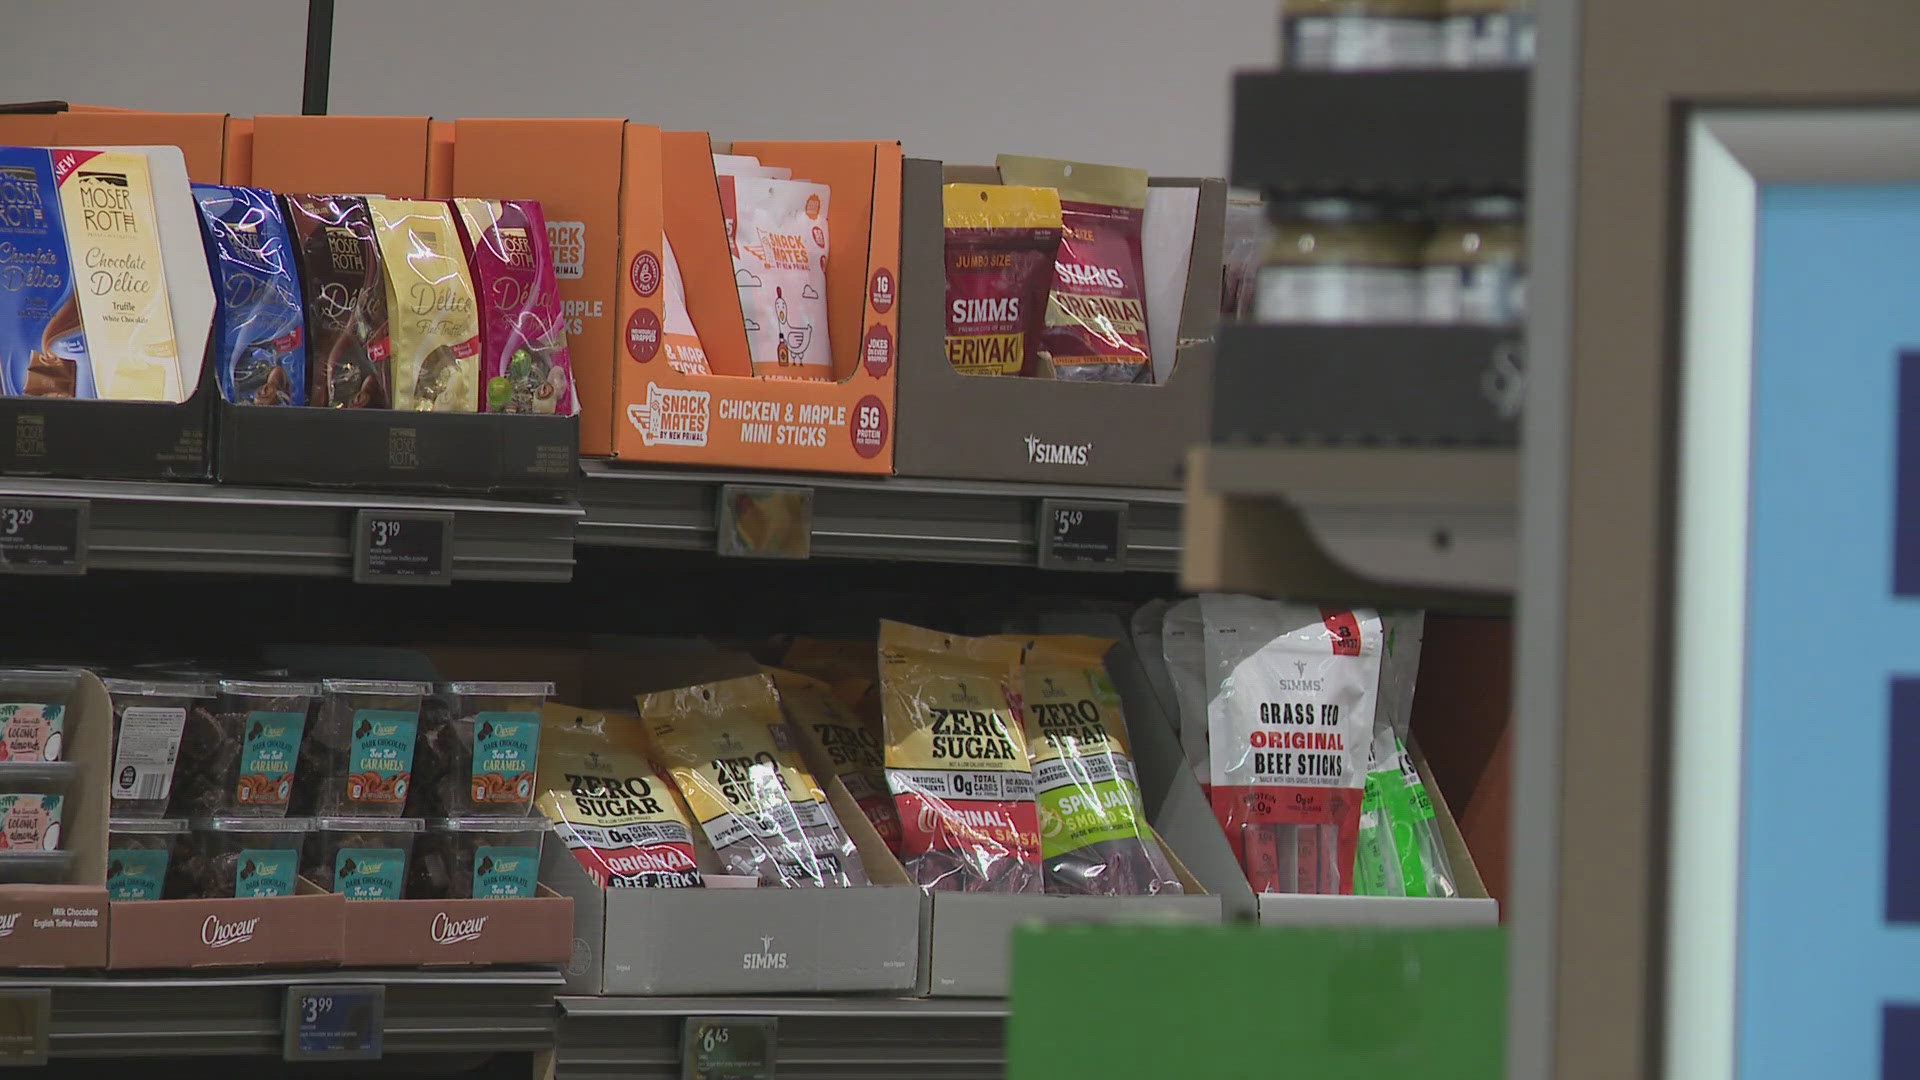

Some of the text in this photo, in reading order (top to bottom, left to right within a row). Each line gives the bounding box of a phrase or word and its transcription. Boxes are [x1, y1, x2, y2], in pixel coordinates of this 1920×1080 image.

[56, 153, 76, 180] NEW
[0, 182, 42, 206] OSER
[79, 187, 133, 211] MOSER
[84, 209, 138, 233] ROTH
[547, 227, 580, 246] ACK
[769, 233, 804, 250] SNACK
[1075, 229, 1094, 242] SIZE
[328, 236, 361, 254] MOSER
[501, 237, 532, 253] OSER
[85, 247, 146, 271] Chocolate
[332, 253, 365, 271] ROTH
[552, 246, 580, 264] TES
[773, 248, 809, 264] MATES
[956, 255, 1012, 268] JUMBO SIZE
[2, 265, 62, 292] Délice
[554, 266, 578, 275] RIMAL
[1055, 262, 1124, 289] SIMMS
[90, 269, 150, 296] Délice
[877, 276, 888, 293] 1G
[112, 301, 136, 312] Truffle
[953, 298, 1019, 323] SIMMS
[103, 315, 120, 323] White
[631, 334, 656, 343] WRAPPED
[868, 339, 888, 350] JOKES
[678, 345, 707, 364] MAP
[945, 338, 1018, 365] ERIYAKI
[662, 395, 707, 413] SNACK
[719, 399, 846, 425] CHICKEN & MAPLE
[660, 413, 704, 431] MATES
[860, 406, 880, 429] 5G
[660, 431, 703, 441] BY NEW PRIMAL
[741, 423, 827, 447] MINI STICKS
[857, 427, 880, 438] PROTEIN
[1036, 443, 1087, 465] SIMMS
[1279, 679, 1321, 692] SIMMS
[929, 708, 1006, 738] ZERO
[1030, 700, 1100, 728] ZERO
[1260, 703, 1339, 726] GRASS FED
[8, 728, 39, 739] COCONUT
[1250, 730, 1344, 750] ORIGINAL
[370, 748, 397, 758] Sea Salt
[492, 749, 518, 759] Sea Salt
[932, 737, 1016, 760] SUGAR
[250, 760, 289, 772] CARAMELS
[361, 758, 404, 771] CARAMELS
[484, 760, 526, 771] CARAMELS
[1086, 757, 1107, 768] TOTAL
[1255, 753, 1342, 776] BEEF STICKS
[565, 773, 651, 799] ZERO
[953, 774, 973, 796] 0g
[974, 775, 996, 783] TOTAL
[974, 783, 998, 792] CARBS
[575, 797, 664, 818] SUGAR
[8, 818, 38, 829] COCONUT
[627, 825, 652, 834] TOTAL
[608, 830, 633, 843] 0g
[608, 852, 693, 872] ORIGINAL
[613, 871, 701, 888] BEEF JERKY
[354, 886, 382, 896] Sea Salt
[491, 885, 518, 895] Sea Salt
[53, 908, 98, 916] Milk Chocolate
[34, 919, 98, 929] English Toffee Almonds
[201, 914, 257, 945] Choceur
[430, 912, 487, 942] Choceur
[743, 953, 786, 969] SIMMS
